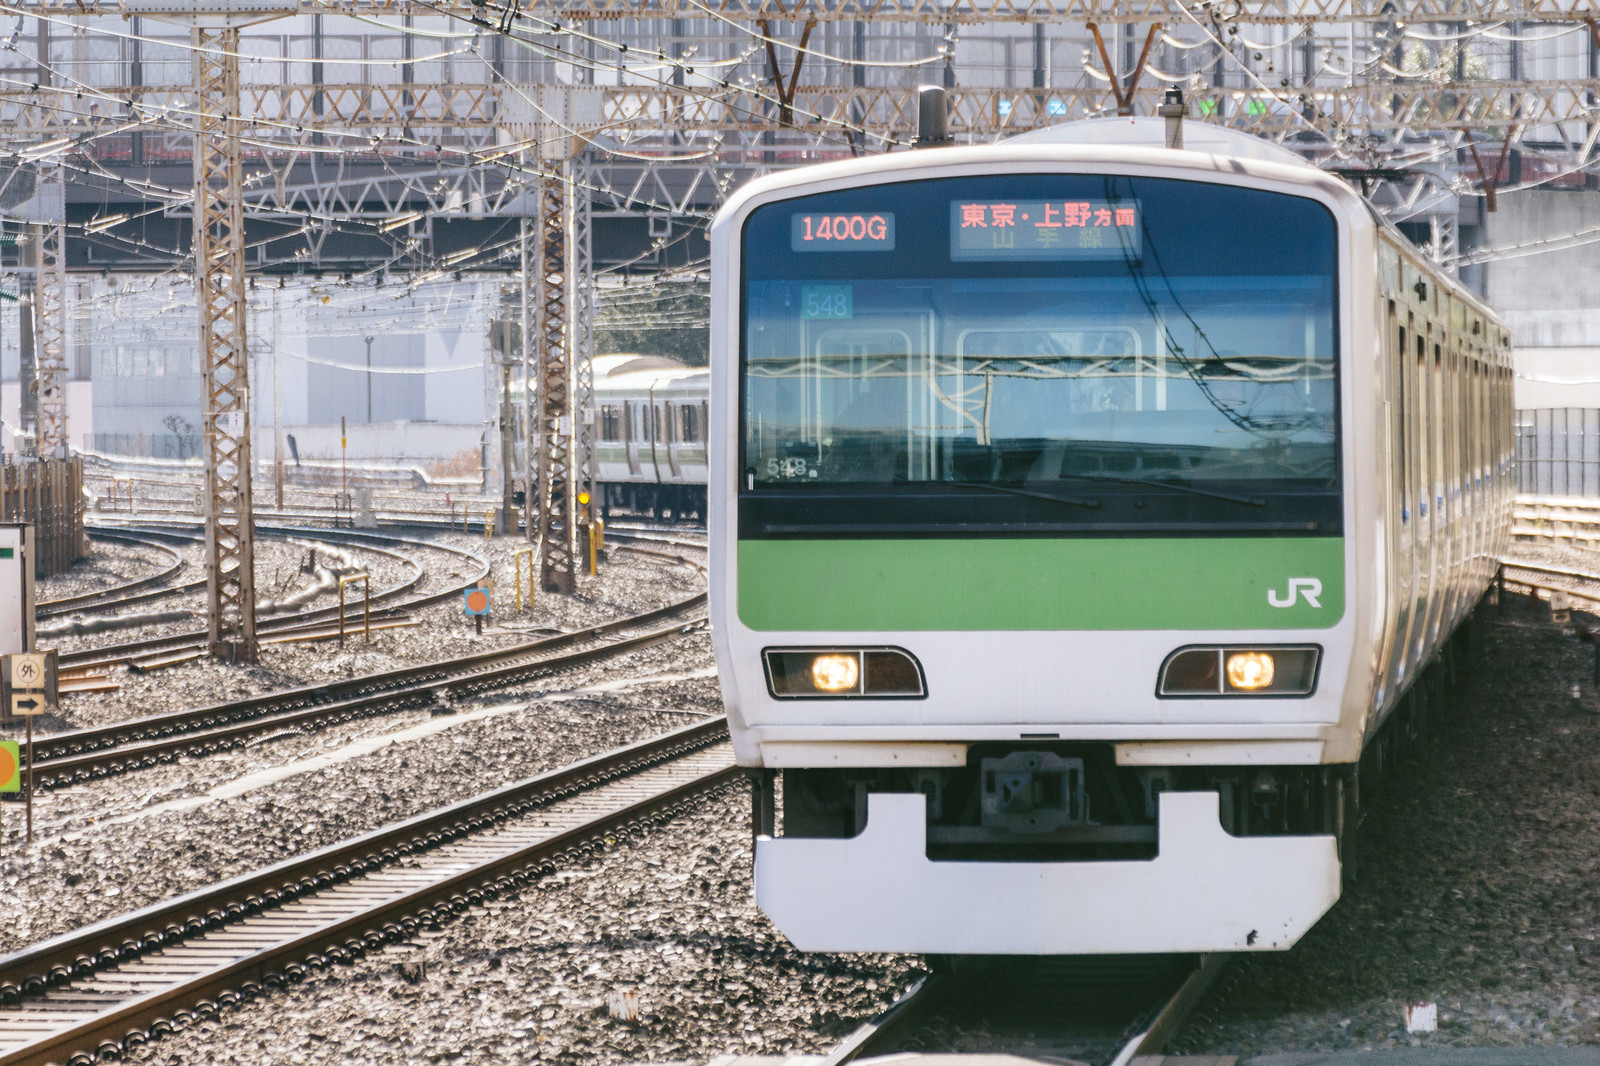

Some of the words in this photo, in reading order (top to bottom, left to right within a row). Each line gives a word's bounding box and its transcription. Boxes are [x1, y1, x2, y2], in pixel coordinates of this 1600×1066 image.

[960, 202, 1135, 228] 東京・上野方面
[803, 215, 887, 241] 1400G
[993, 228, 1103, 249] 山手線
[806, 293, 848, 317] 548
[1267, 577, 1323, 608] JR
[21, 664, 36, 678] 外
